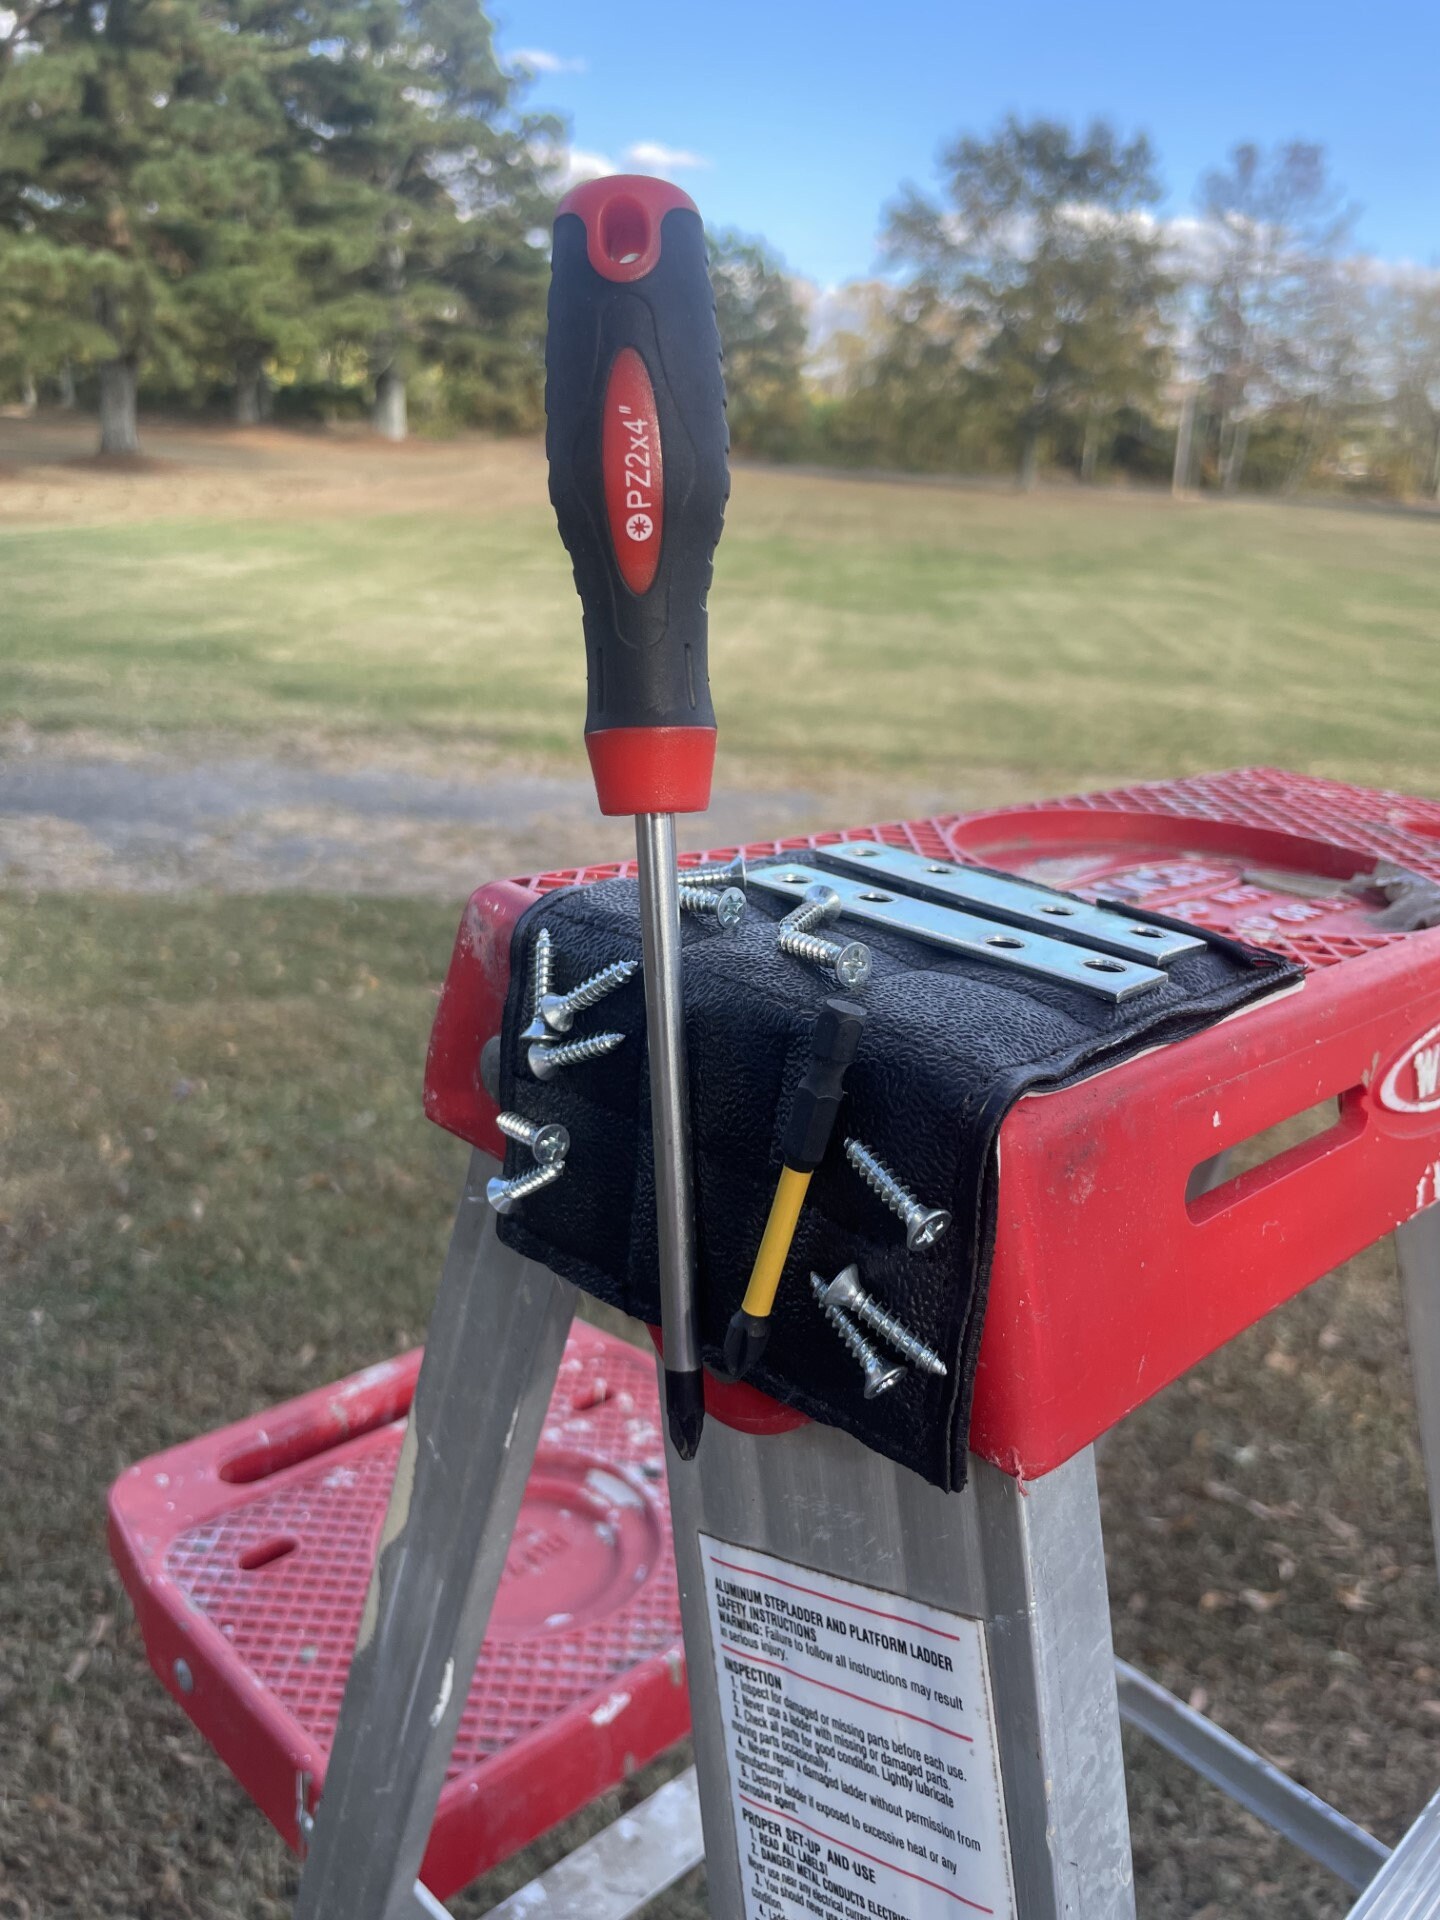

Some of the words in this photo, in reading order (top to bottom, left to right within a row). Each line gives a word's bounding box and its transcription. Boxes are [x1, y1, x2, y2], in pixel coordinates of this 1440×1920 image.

[618, 405, 652, 509] PZ2x4"
[715, 1577, 763, 1606] ALUMINUM
[764, 1593, 823, 1628] STEPLADDER
[826, 1616, 847, 1635] AND
[849, 1623, 907, 1655] PLATFORM
[910, 1642, 953, 1672] LADDER
[716, 1593, 746, 1618] SAFETY
[749, 1606, 817, 1642] INSTRUCTIONS
[720, 1624, 728, 1638] in
[728, 1629, 759, 1650] serious
[761, 1639, 789, 1661] injury.
[718, 1608, 763, 1636] WARNING:
[765, 1625, 793, 1647] Failure
[794, 1639, 803, 1653] to
[805, 1641, 833, 1663] follow
[835, 1654, 847, 1668] all
[848, 1657, 908, 1689] instructions
[910, 1681, 931, 1701] may
[934, 1690, 963, 1711] result
[723, 1655, 782, 1690] INSPECTION
[731, 1675, 739, 1689] 1.
[740, 1679, 770, 1700] Inspect
[771, 1689, 782, 1704] for
[783, 1696, 819, 1721] damaged
[820, 1714, 829, 1726] or
[831, 1718, 865, 1743] missing
[867, 1732, 890, 1750] parts
[891, 1740, 921, 1762] before
[924, 1753, 945, 1772] each
[947, 1764, 967, 1782] use.
[732, 1689, 740, 1704] 2.
[741, 1693, 764, 1713] Never
[766, 1705, 781, 1719] use
[782, 1711, 788, 1722] a
[789, 1711, 812, 1733] ladder
[814, 1725, 832, 1742] with
[833, 1733, 867, 1759] missing
[869, 1748, 878, 1761] or
[880, 1752, 923, 1778] damaged
[925, 1770, 951, 1791] parts.
[743, 1709, 769, 1729] Check
[769, 1720, 779, 1733] all
[780, 1725, 800, 1743] parts
[801, 1732, 812, 1748] for
[814, 1741, 836, 1758] good
[837, 1750, 880, 1777] condition.
[881, 1766, 914, 1792] Lightly
[915, 1779, 954, 1808] lubricate
[759, 1732, 780, 1749] parts
[781, 1741, 831, 1773] occasionally.
[748, 1740, 770, 1758] Never
[772, 1751, 795, 1768] repair
[796, 1761, 801, 1773] a
[802, 1764, 839, 1790] damaged
[840, 1780, 867, 1802] ladder
[869, 1794, 903, 1818] without
[905, 1808, 955, 1842] permission
[957, 1830, 981, 1851] from
[751, 1769, 782, 1794] Destroy
[783, 1782, 807, 1804] ladder
[808, 1794, 814, 1808] if
[815, 1801, 850, 1825] exposed
[851, 1815, 861, 1830] to
[862, 1821, 905, 1849] excessive
[906, 1838, 928, 1859] heat
[929, 1851, 939, 1864] or
[941, 1856, 957, 1875] any
[742, 1807, 782, 1838] PROPER
[785, 1826, 821, 1856] SET-UP
[827, 1848, 849, 1870] AND
[852, 1860, 876, 1884] USE
[758, 1831, 779, 1851] READ
[782, 1841, 796, 1859] ALL
[798, 1848, 828, 1876] LABELS!
[760, 1847, 795, 1873] DANGER!
[796, 1862, 821, 1887] METAL
[822, 1877, 865, 1909] CONDUCTS
[763, 1877, 779, 1895] You
[780, 1884, 805, 1907] should
[767, 1867, 780, 1881] use
[781, 1873, 798, 1888] near
[799, 1881, 811, 1898] any
[812, 1887, 843, 1913] electrical
